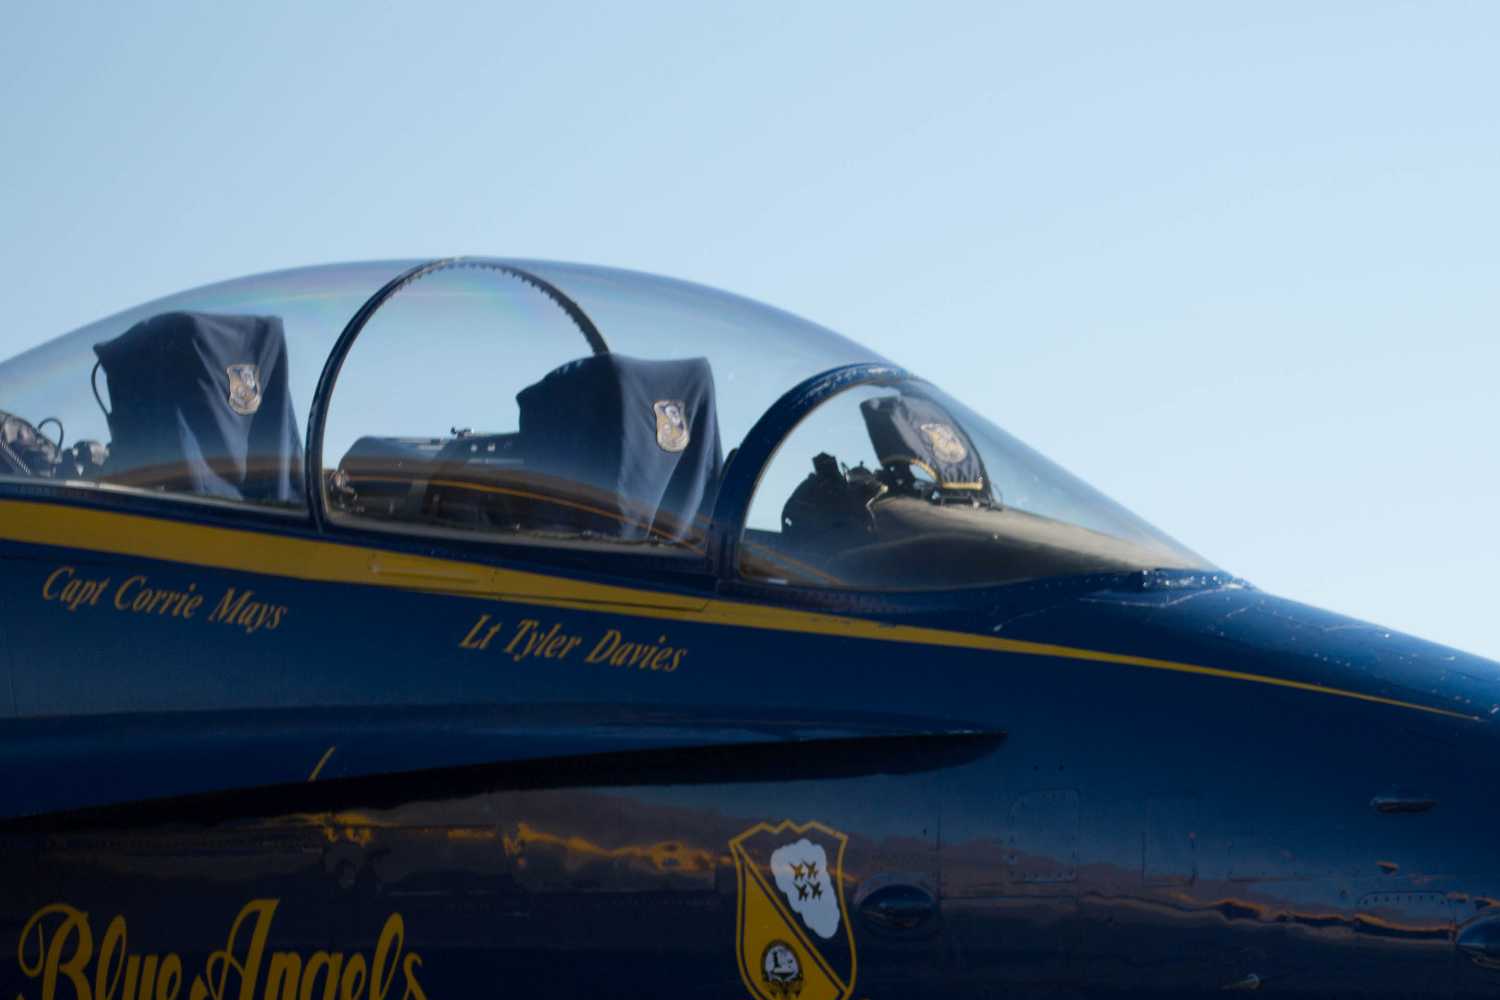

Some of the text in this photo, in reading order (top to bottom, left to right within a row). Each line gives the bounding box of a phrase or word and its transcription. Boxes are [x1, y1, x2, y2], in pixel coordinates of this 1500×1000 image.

[42, 565, 288, 634] Capt Corrie Mays
[458, 614, 688, 673] Lt Tyler Davies
